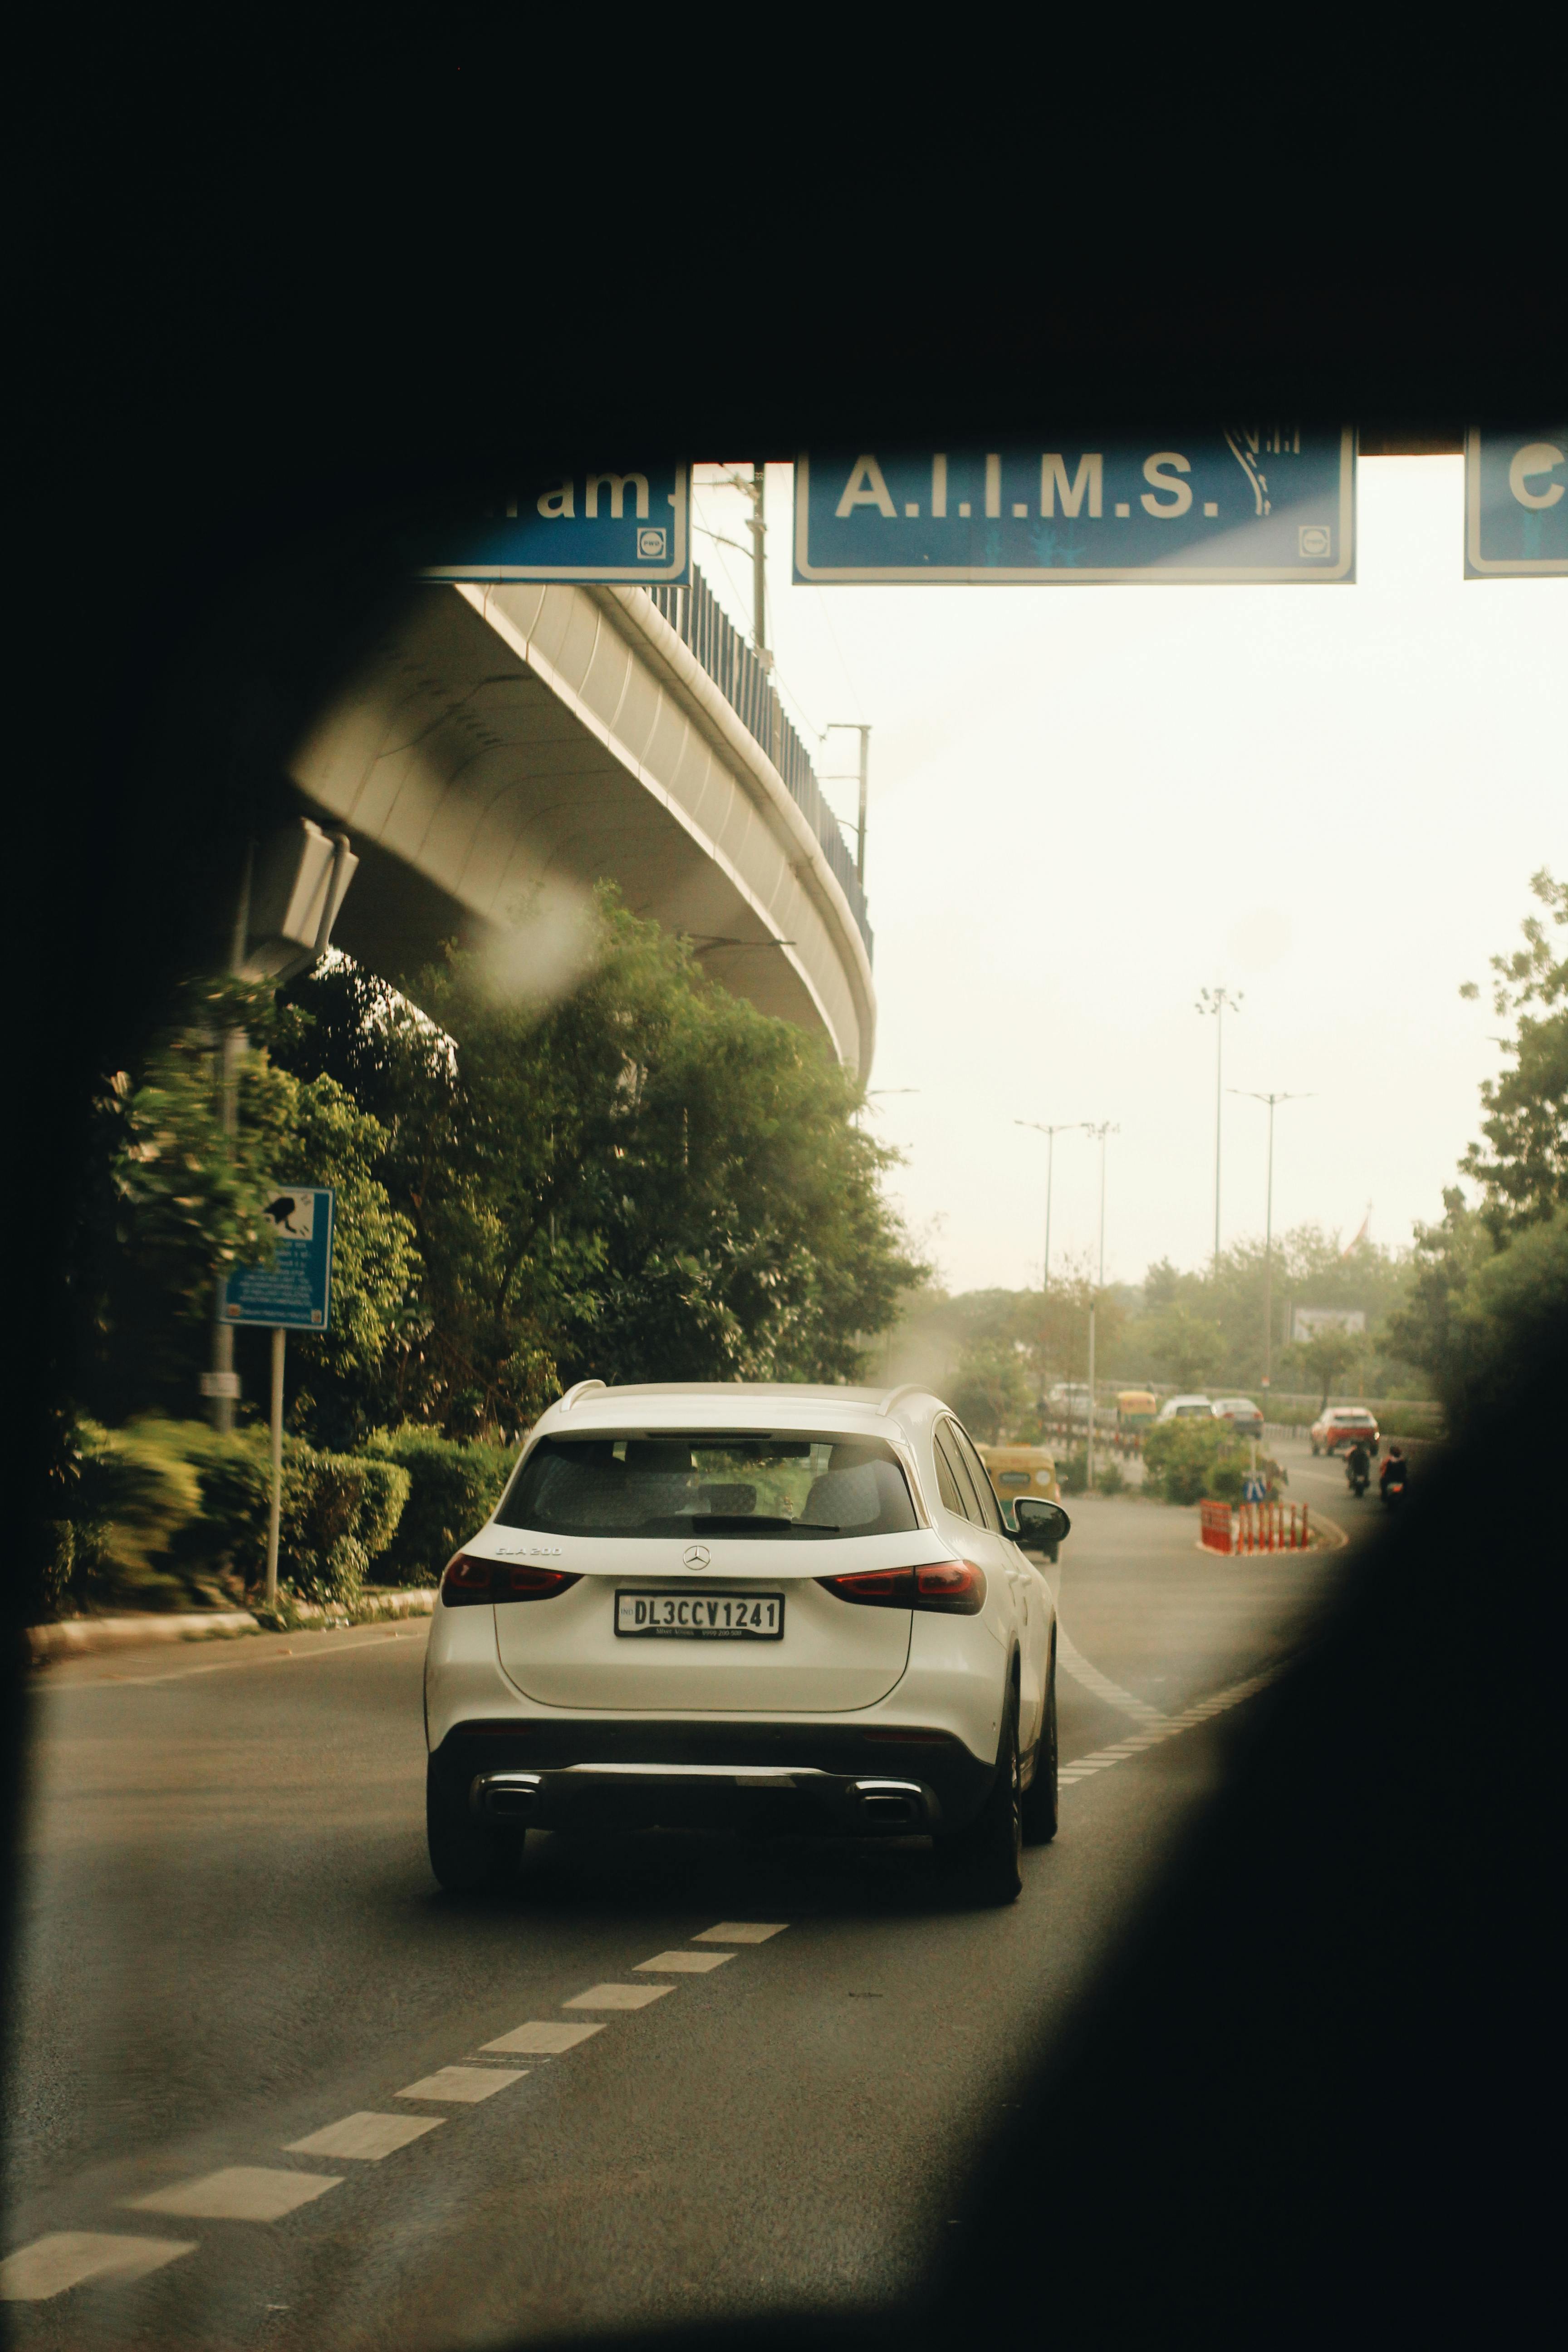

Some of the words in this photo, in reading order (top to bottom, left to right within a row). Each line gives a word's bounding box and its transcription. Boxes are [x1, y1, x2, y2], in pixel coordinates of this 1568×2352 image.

[835, 452, 1218, 518] A.I.I.M.S.
[496, 1546, 527, 1555] GLA
[530, 1546, 563, 1556] 200
[635, 1600, 775, 1627] DL3CCV1241
